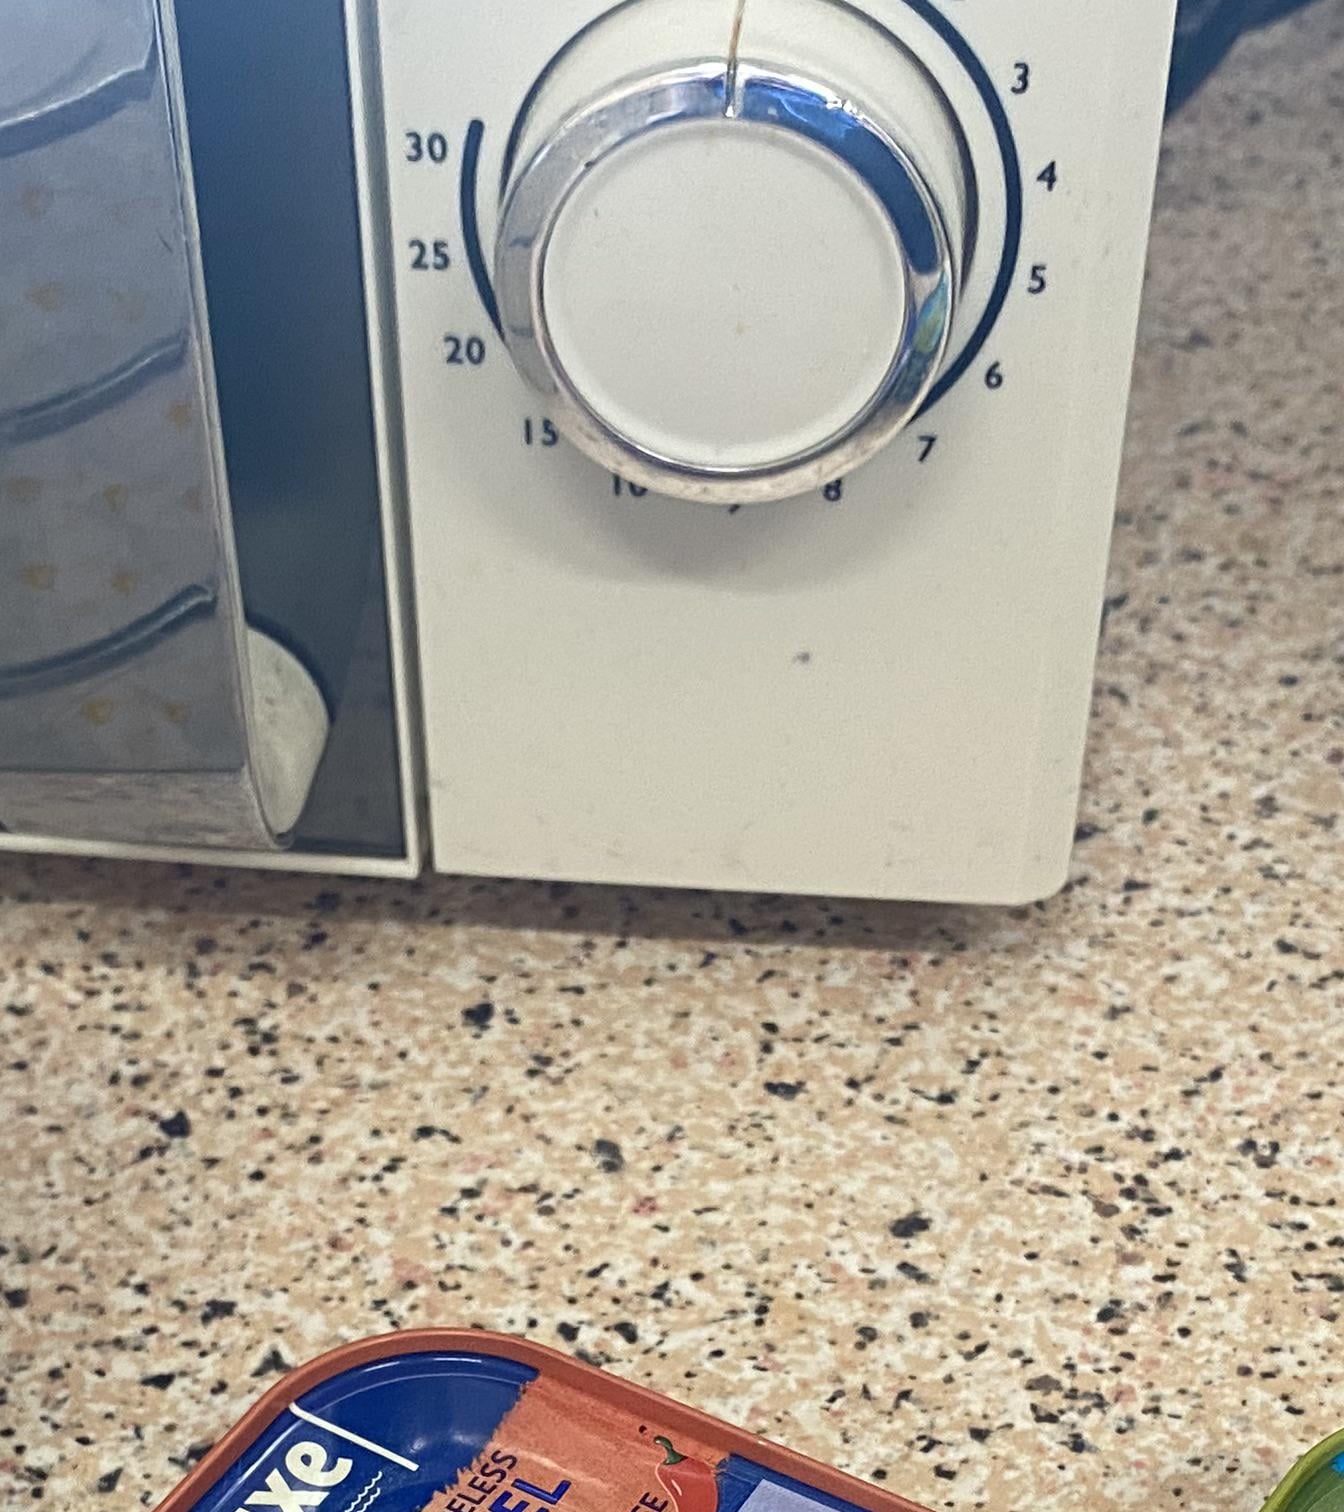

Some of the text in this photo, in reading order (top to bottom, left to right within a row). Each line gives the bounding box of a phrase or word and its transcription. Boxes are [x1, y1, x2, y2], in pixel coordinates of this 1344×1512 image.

[1012, 64, 1029, 92] 3
[406, 133, 447, 162] 30
[1037, 161, 1058, 190] 4
[409, 240, 450, 270] 25
[1027, 266, 1046, 294] 5
[444, 336, 485, 365] 20
[984, 362, 1003, 390] 6
[523, 418, 558, 447] 15
[916, 436, 937, 462] 7
